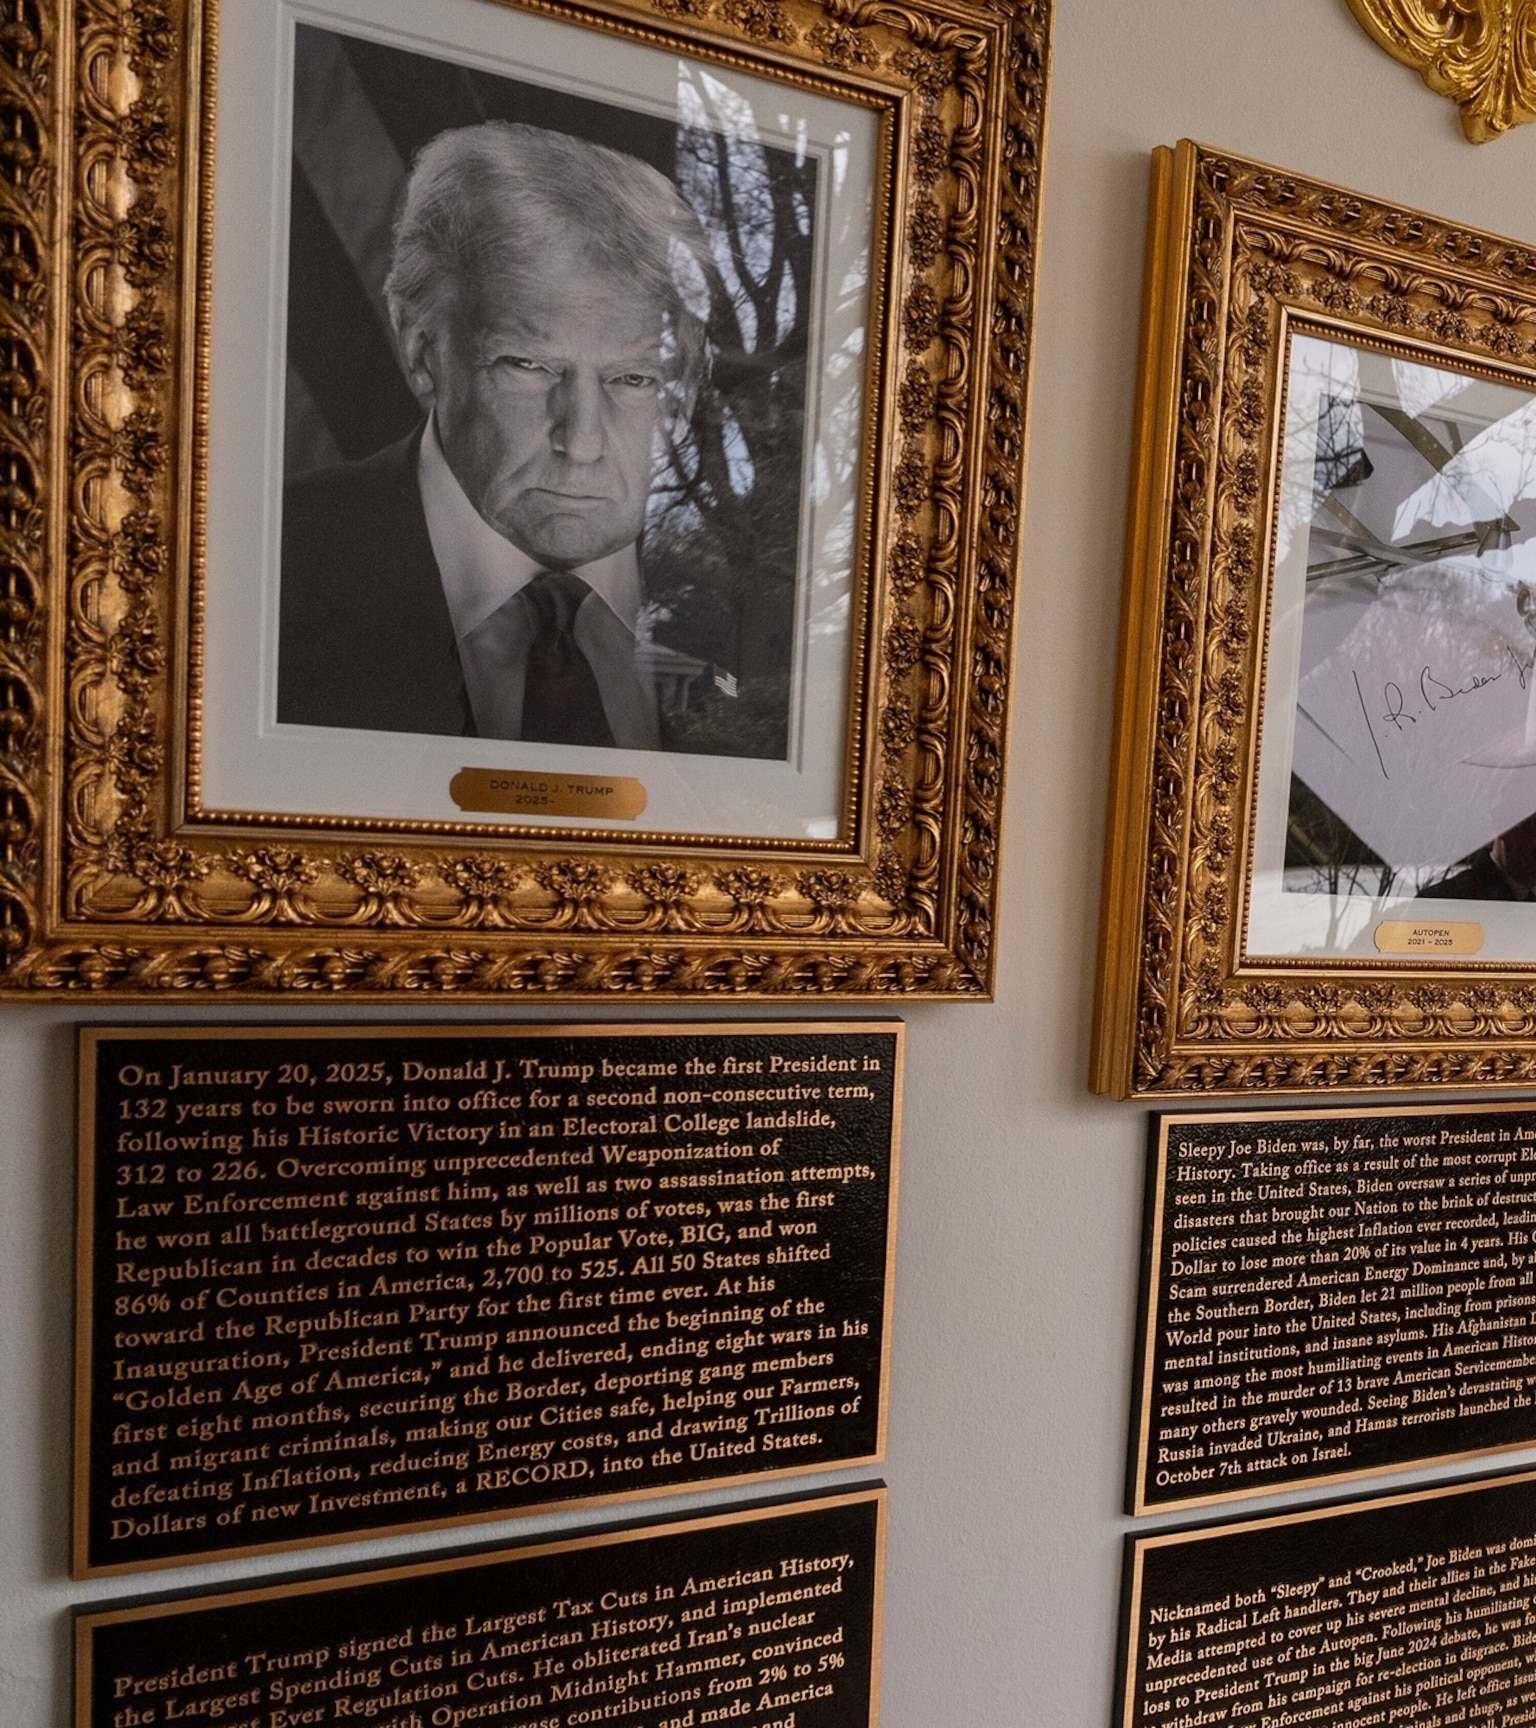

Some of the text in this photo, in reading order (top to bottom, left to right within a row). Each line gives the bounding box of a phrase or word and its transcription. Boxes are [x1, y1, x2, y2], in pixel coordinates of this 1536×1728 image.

[489, 779, 549, 793] DONALD
[567, 784, 615, 796] TRUMP
[1412, 929, 1450, 937] AUTOPEN
[118, 1054, 880, 1090] On January 20, 2025, Donald J. Trump became the first President in
[1178, 1141, 1226, 1161] Sleepy
[1227, 1140, 1252, 1159] Joe
[1256, 1138, 1296, 1154] Biden
[1300, 1140, 1329, 1153] was,
[1333, 1135, 1349, 1154] by
[1352, 1134, 1374, 1150] far,
[1379, 1133, 1399, 1148] the
[1402, 1134, 1437, 1146] worst
[1439, 1128, 1496, 1144] President
[1498, 1128, 1510, 1142] in
[1170, 1259, 1218, 1276] Dollar
[1221, 1260, 1236, 1272] to
[1240, 1255, 1268, 1270] lose
[1272, 1254, 1306, 1267] more
[1310, 1248, 1339, 1264] than
[1343, 1245, 1371, 1261] 20%
[1374, 1242, 1390, 1258] of
[1390, 1243, 1406, 1257] its
[1410, 1239, 1441, 1255] value
[1444, 1238, 1457, 1251] in
[1460, 1236, 1468, 1249] 4
[1470, 1237, 1504, 1253] years.
[1507, 1231, 1528, 1245] His
[115, 1242, 831, 1316] 86% of Counties in America, 2,700 to 525. All 50 States shifted
[1156, 1442, 1351, 1486] October 7th attack on Israel.
[110, 1433, 823, 1540] Dollars of new Investment, a RECORD, into the United States.
[114, 1554, 854, 1698] President Trump signed the Largest Tax Cuts in American History,
[1145, 1657, 1247, 1693] unprecedented
[1252, 1655, 1273, 1669] use
[1277, 1646, 1294, 1663] of
[1295, 1644, 1316, 1659] the
[1319, 1633, 1378, 1654] Autopen.
[1381, 1617, 1442, 1640] Following
[1445, 1610, 1462, 1625] his
[1465, 1597, 1530, 1620] humiliating
